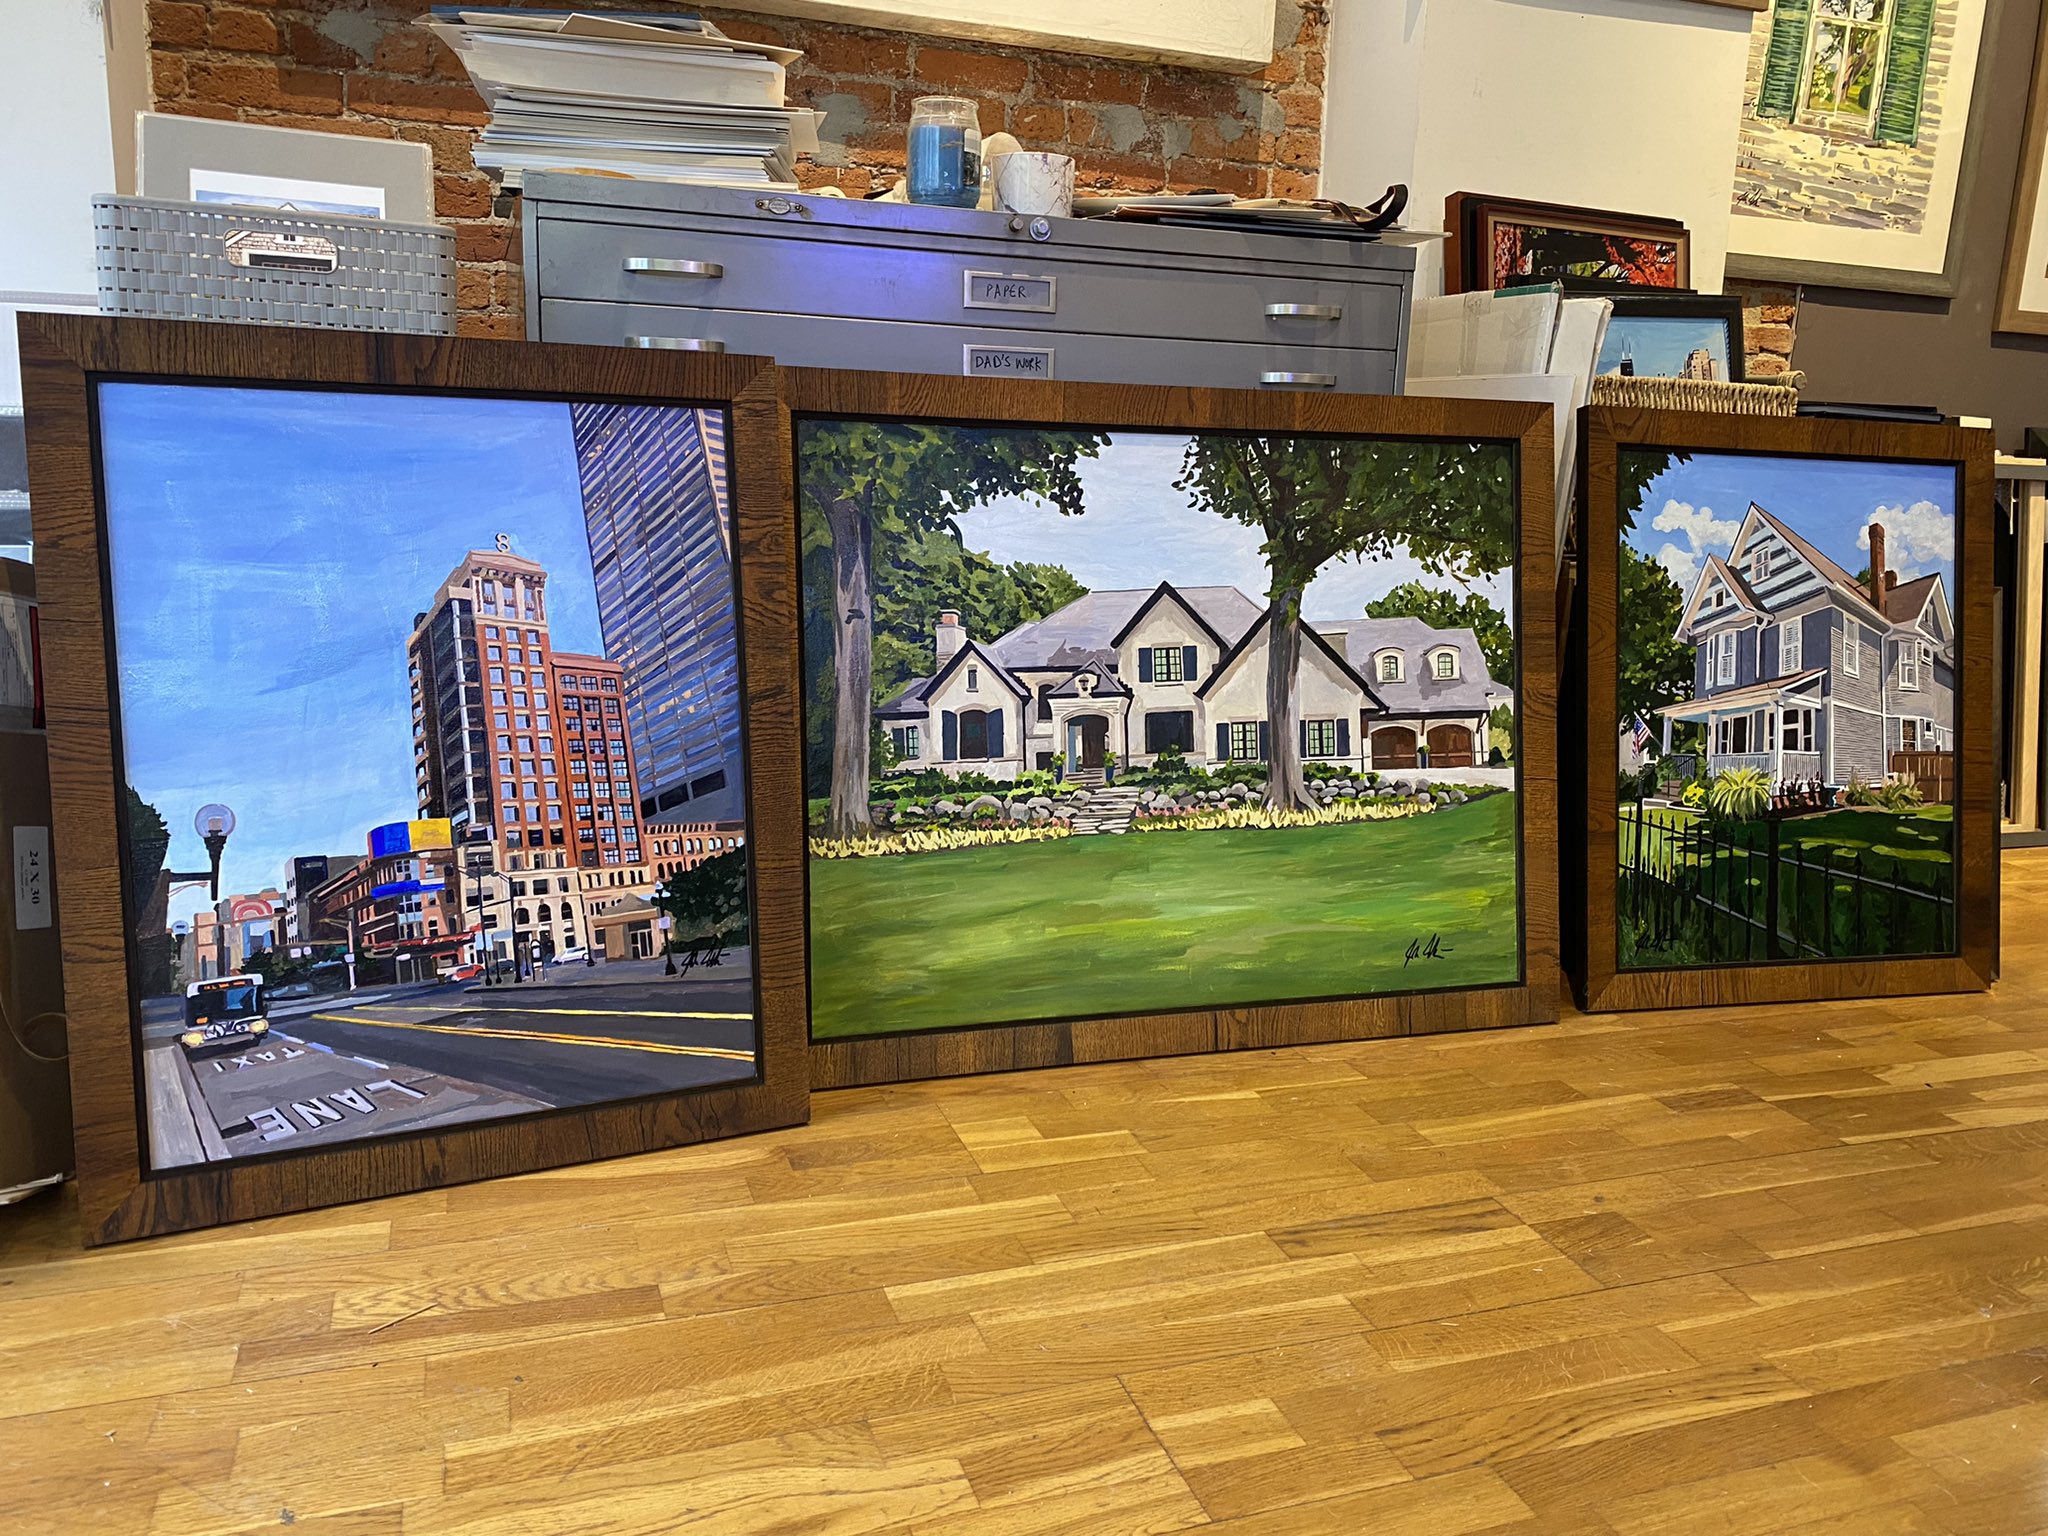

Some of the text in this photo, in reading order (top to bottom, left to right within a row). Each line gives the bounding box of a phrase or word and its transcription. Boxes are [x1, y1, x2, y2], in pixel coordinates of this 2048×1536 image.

[986, 283, 1027, 300] PAPER
[975, 354, 1042, 372] DAD'S WORK
[29, 850, 39, 867] 24
[30, 888, 41, 905] 30
[212, 1046, 305, 1073] TAXI
[246, 1079, 429, 1143] LANE
